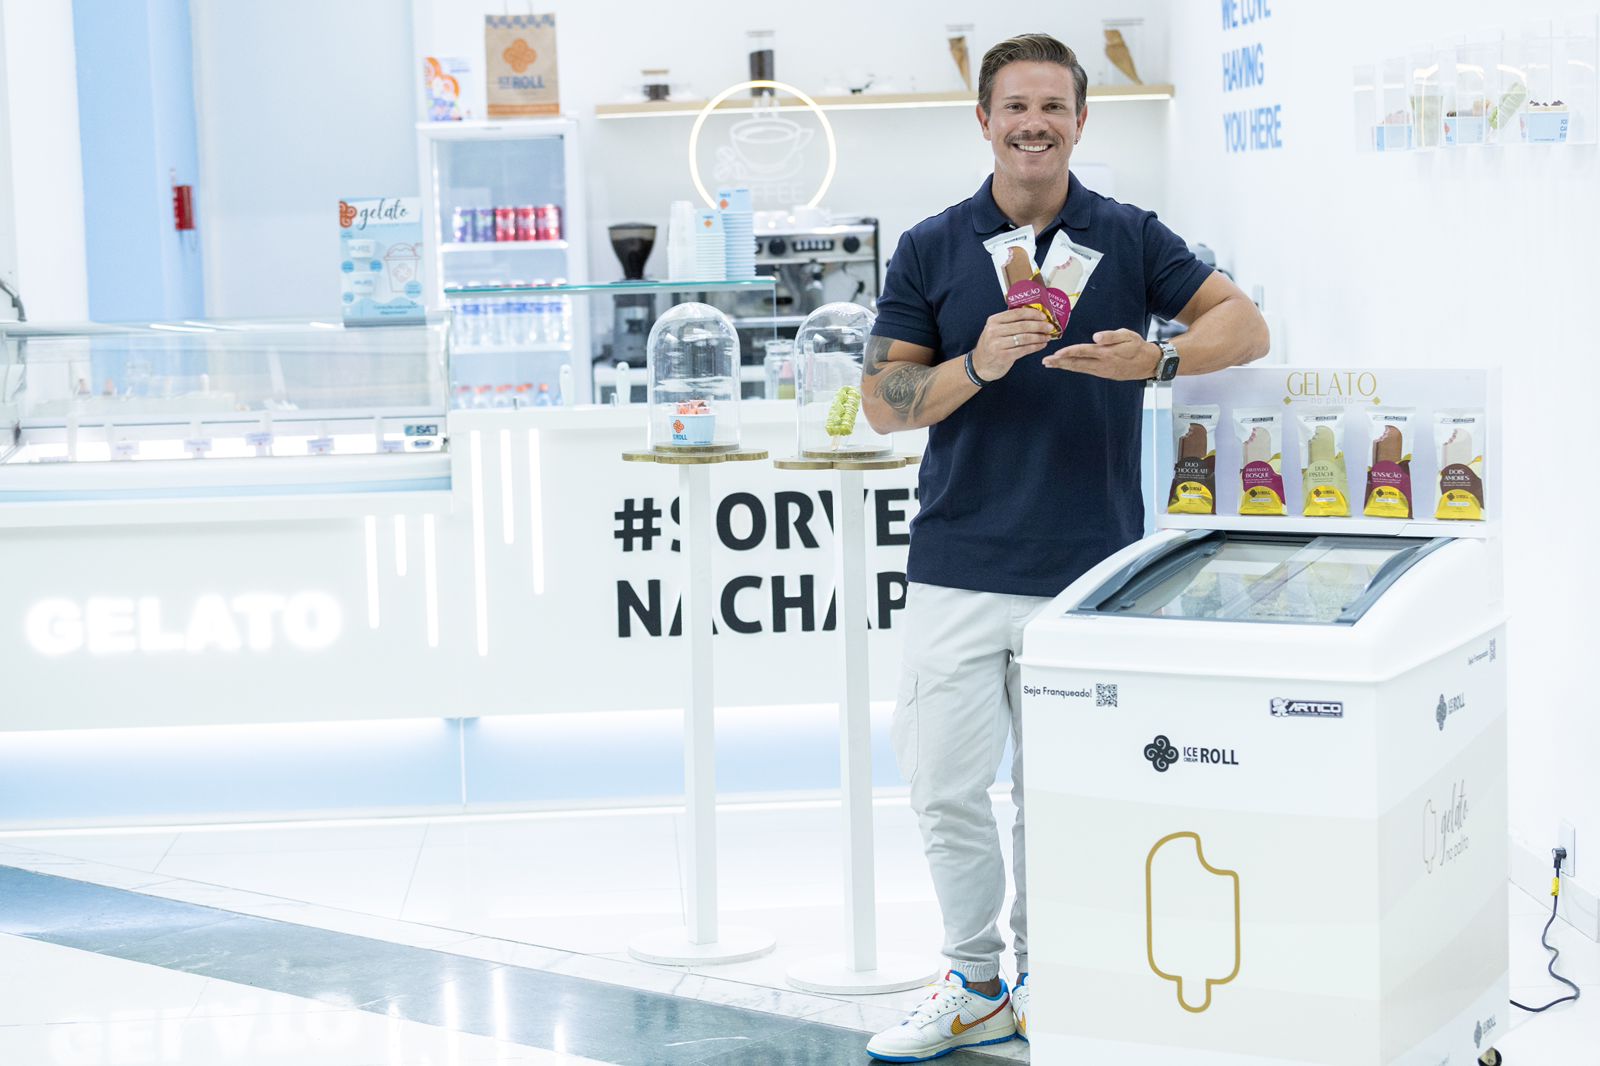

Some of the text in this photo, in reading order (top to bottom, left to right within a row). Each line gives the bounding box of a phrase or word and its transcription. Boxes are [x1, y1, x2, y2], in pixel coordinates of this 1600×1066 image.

[1221, 0, 1239, 31] WE
[1222, 42, 1265, 92] HAVING
[1223, 104, 1283, 153] YOU HERE
[357, 198, 409, 231] gelato
[1286, 371, 1377, 396] GELATO
[617, 571, 909, 638] NCHP
[26, 590, 341, 657] GELATO
[1023, 685, 1093, 699] Seja Franqueado!
[1288, 702, 1342, 713] ARTICO
[1183, 746, 1239, 765] ICE ROLL
